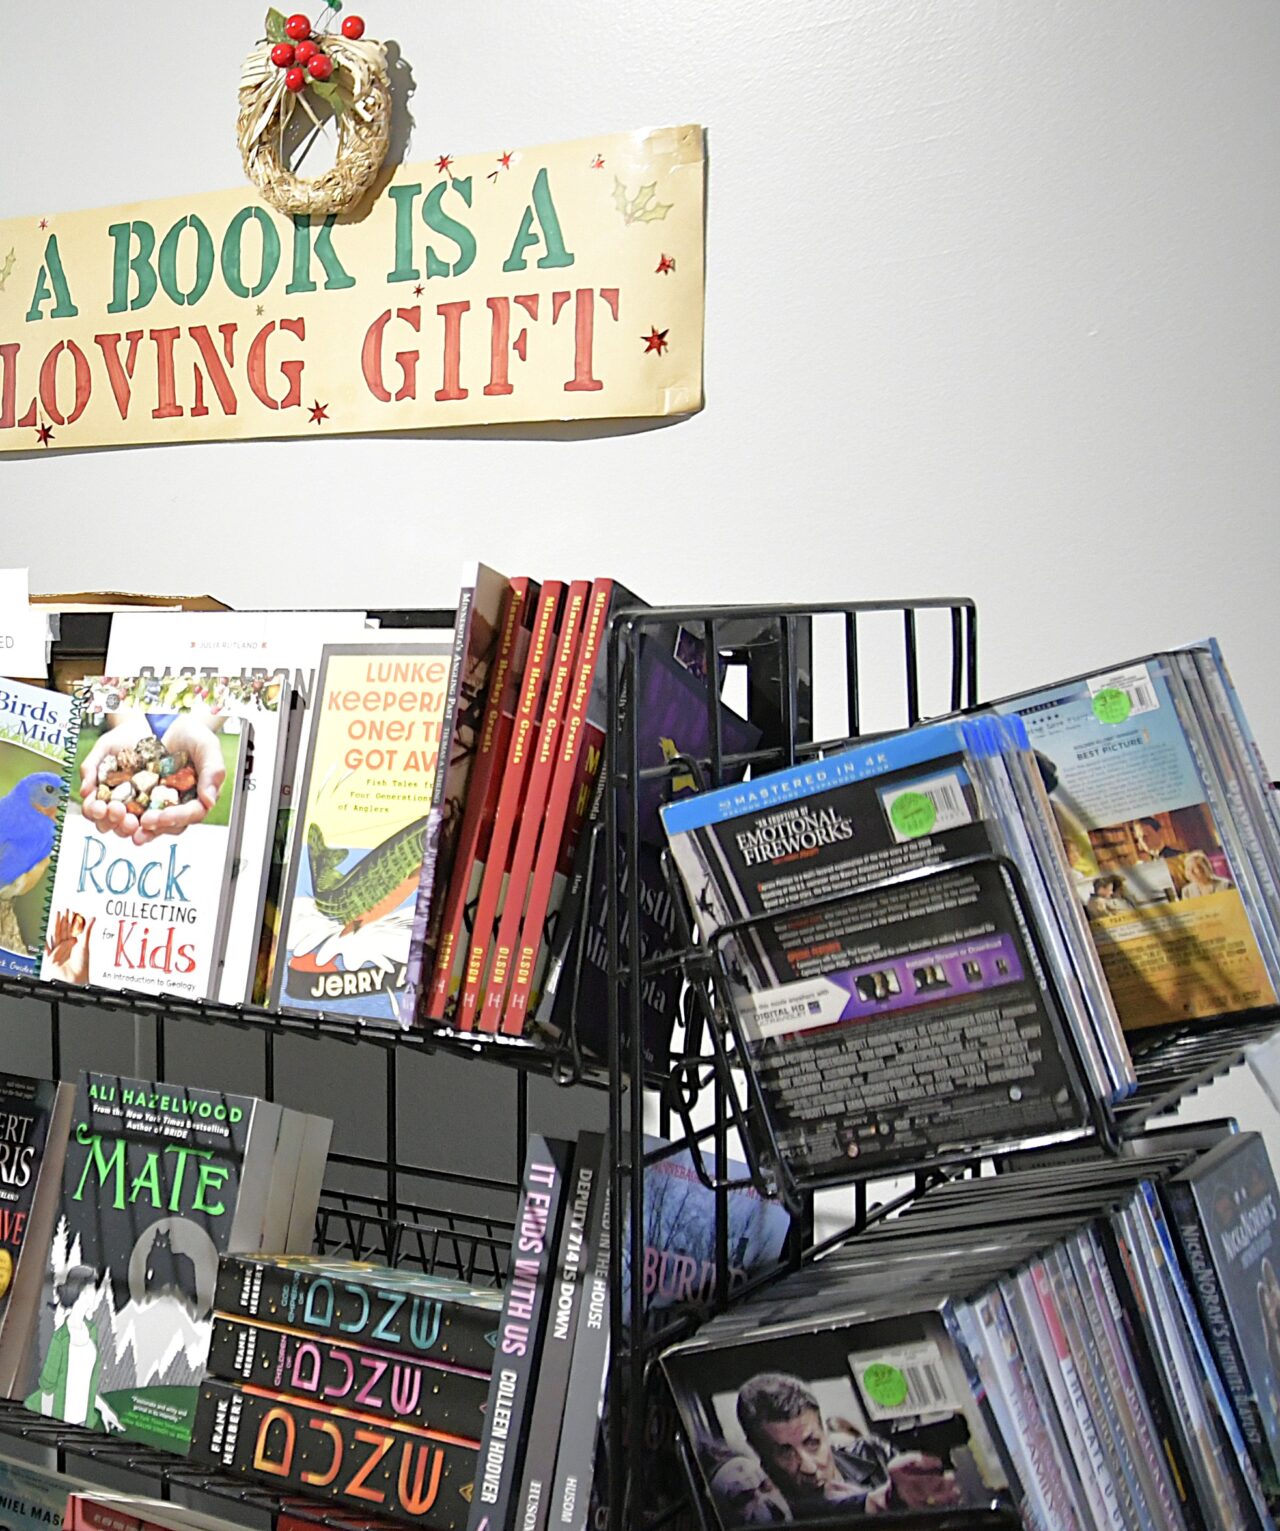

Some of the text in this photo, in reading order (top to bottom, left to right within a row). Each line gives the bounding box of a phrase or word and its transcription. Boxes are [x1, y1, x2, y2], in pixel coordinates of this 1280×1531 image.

[26, 168, 575, 322] A BOOK IS A
[362, 288, 620, 402] GIFT
[491, 660, 508, 703] Hockey
[513, 596, 554, 764] Minnesota Hockey Greats
[540, 595, 582, 763] Minnesota Hockey Greats
[564, 592, 606, 762] Minnesota Hockey Greats
[345, 749, 398, 771] GOT
[1076, 749, 1100, 761] BEST
[1102, 737, 1143, 753] PICTURE
[735, 753, 888, 806] MASTERED IN 4K
[735, 806, 842, 852] EMOTIONAL
[77, 836, 192, 902] Rock
[106, 899, 197, 924] COLLECTING
[102, 920, 197, 975] for Kids
[467, 947, 483, 984] OLSON
[493, 947, 509, 984] OLSON
[518, 948, 533, 984] OLSON
[754, 1004, 805, 1020] DIGITAL HD
[89, 1084, 243, 1123] ALI HAZELWOOD
[93, 1104, 230, 1137] From the New York Times Bestselling
[126, 1120, 189, 1139] Author of BRIDE
[72, 1122, 230, 1217] MATE
[553, 1168, 593, 1340] DEPUTY 714 IS DOWN
[240, 1268, 253, 1306] FRANK
[249, 1264, 264, 1315] HERBERT
[234, 1331, 248, 1369] FRANK
[243, 1328, 257, 1378] HERBERT
[480, 1163, 556, 1504] IT ENDS WITH US COLLEEN HOOVER
[274, 1334, 287, 1387] CHILDREN
[560, 1233, 610, 1524] IN THE HOUSE HUSOM
[211, 1400, 228, 1453] FRANK
[222, 1394, 244, 1465] HERBERT
[1065, 1366, 1106, 1475] THE HATE
